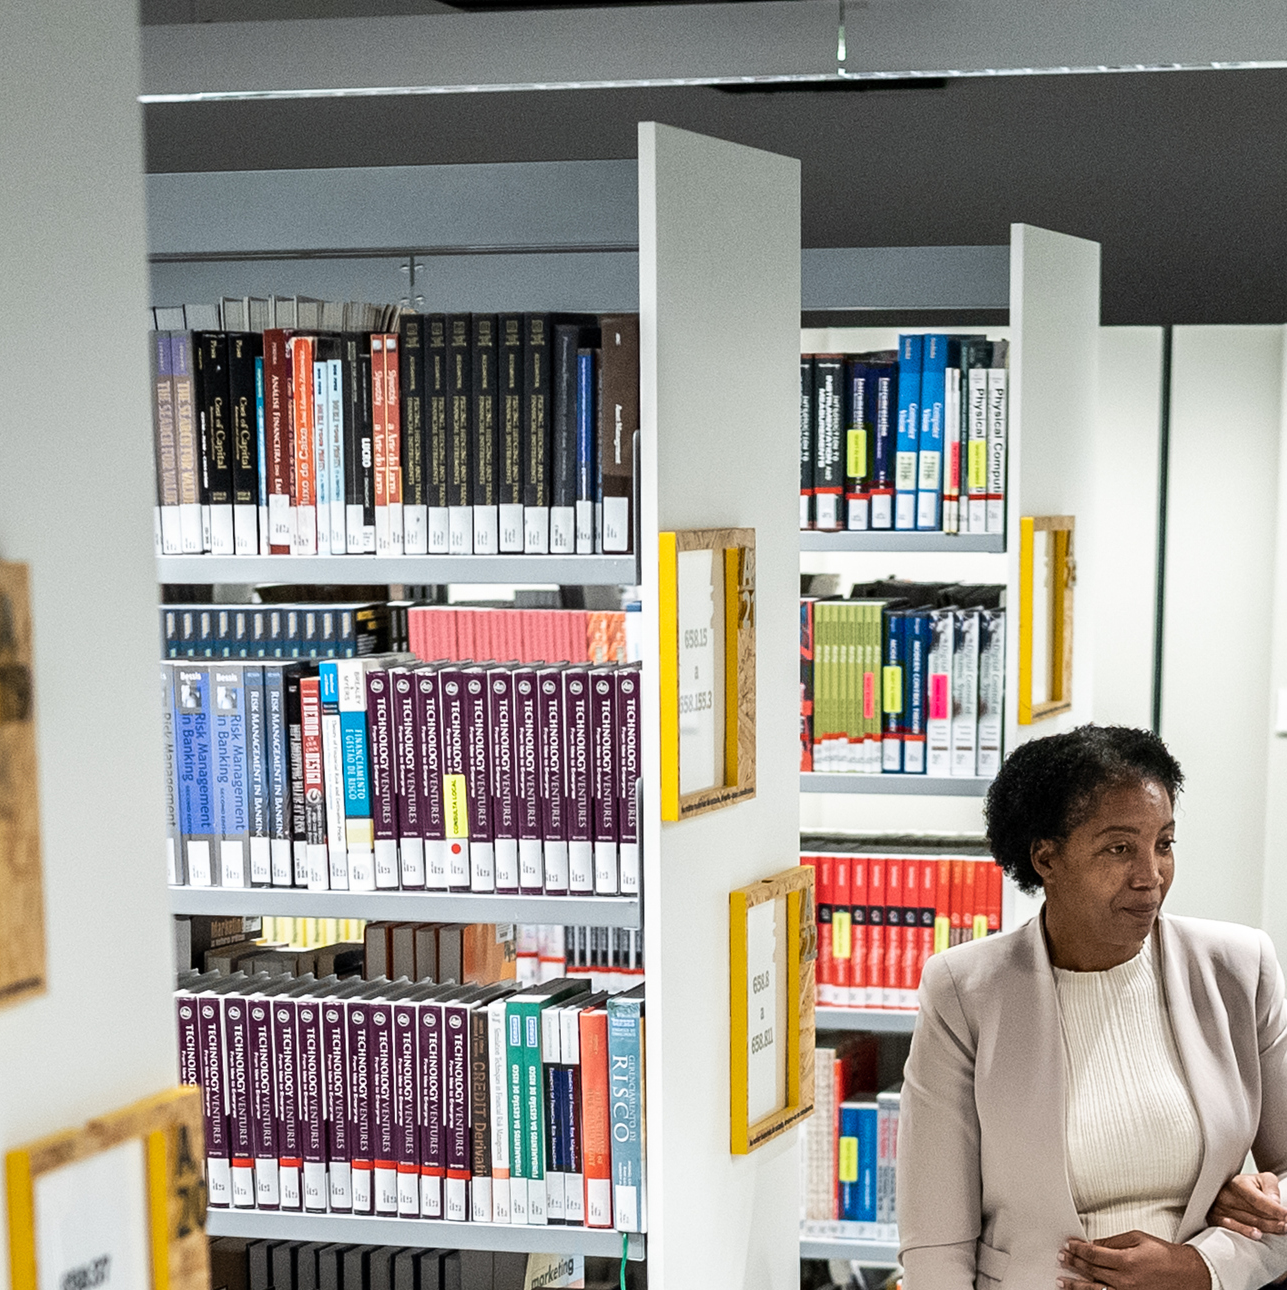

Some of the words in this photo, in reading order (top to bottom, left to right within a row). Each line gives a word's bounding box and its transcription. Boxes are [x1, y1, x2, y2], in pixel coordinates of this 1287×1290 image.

[974, 388, 985, 438] Physical
[992, 388, 1004, 438] Physical
[239, 430, 251, 469] Capital
[992, 443, 1004, 493] Computi
[182, 714, 193, 726] in
[195, 713, 207, 740] Risk
[218, 715, 228, 726] in
[231, 714, 242, 740] Risk
[250, 691, 259, 712] RISK
[270, 691, 280, 712] RISK
[181, 730, 194, 781] Banking
[216, 731, 230, 783] Banking
[251, 714, 261, 782] MANAGEMENT
[271, 714, 282, 782] MANAGEMENT
[376, 698, 389, 770] TECHNOLOGY
[402, 698, 415, 771] TECHNOLOGY
[451, 702, 462, 774] TECHNOLOGY
[473, 700, 486, 772] TECHNOLOGY
[524, 700, 536, 772] TECHNOLOGY
[196, 743, 211, 828] Management
[231, 745, 246, 830] Management
[354, 729, 366, 799] FINANCIAMENTO
[254, 784, 262, 796] IN
[274, 784, 282, 796] IN
[381, 772, 391, 824] VENTURES
[408, 772, 417, 824] VENTURES
[477, 774, 487, 827] VENTURES
[527, 774, 537, 828] VENTURES
[753, 970, 769, 994] 658.8
[760, 1006, 764, 1020] a
[207, 1024, 218, 1096] TECHNOLOGY
[234, 1025, 245, 1094] TECHNOLOGY
[331, 1028, 343, 1099] TECHNOLOGY
[751, 1027, 773, 1056] 658.811
[454, 1034, 464, 1103] TECHNOLOGY
[211, 1096, 221, 1144] VENTURES
[238, 1095, 248, 1145] VENTURES
[335, 1099, 345, 1149] VENTURES
[612, 1055, 629, 1143] RISCO
[456, 1105, 464, 1156] VENTURES
[530, 1132, 539, 1178] FUNDAMENTOS
[531, 1258, 574, 1289] marketing
